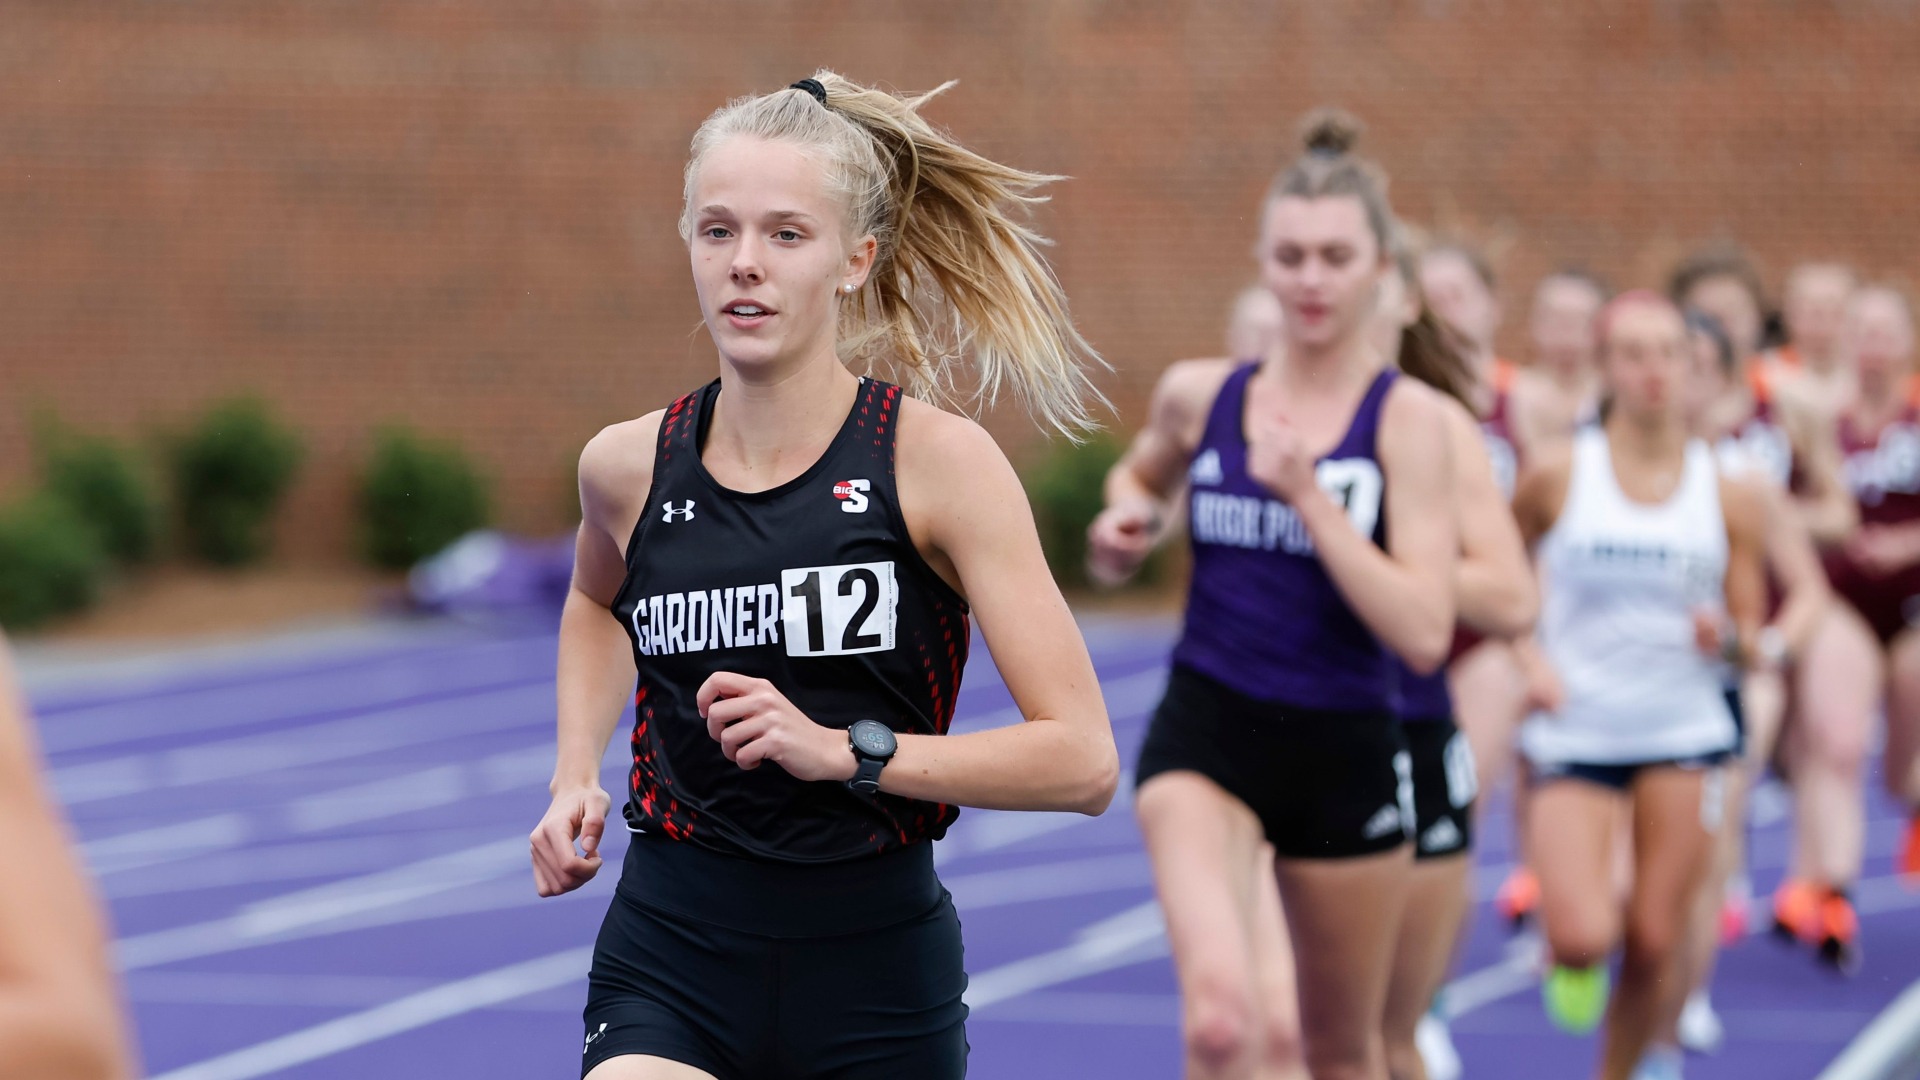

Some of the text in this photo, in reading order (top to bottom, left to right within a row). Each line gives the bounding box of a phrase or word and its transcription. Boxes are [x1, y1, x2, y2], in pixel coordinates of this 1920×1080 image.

[833, 479, 871, 513] BIG S
[790, 567, 882, 653] 12
